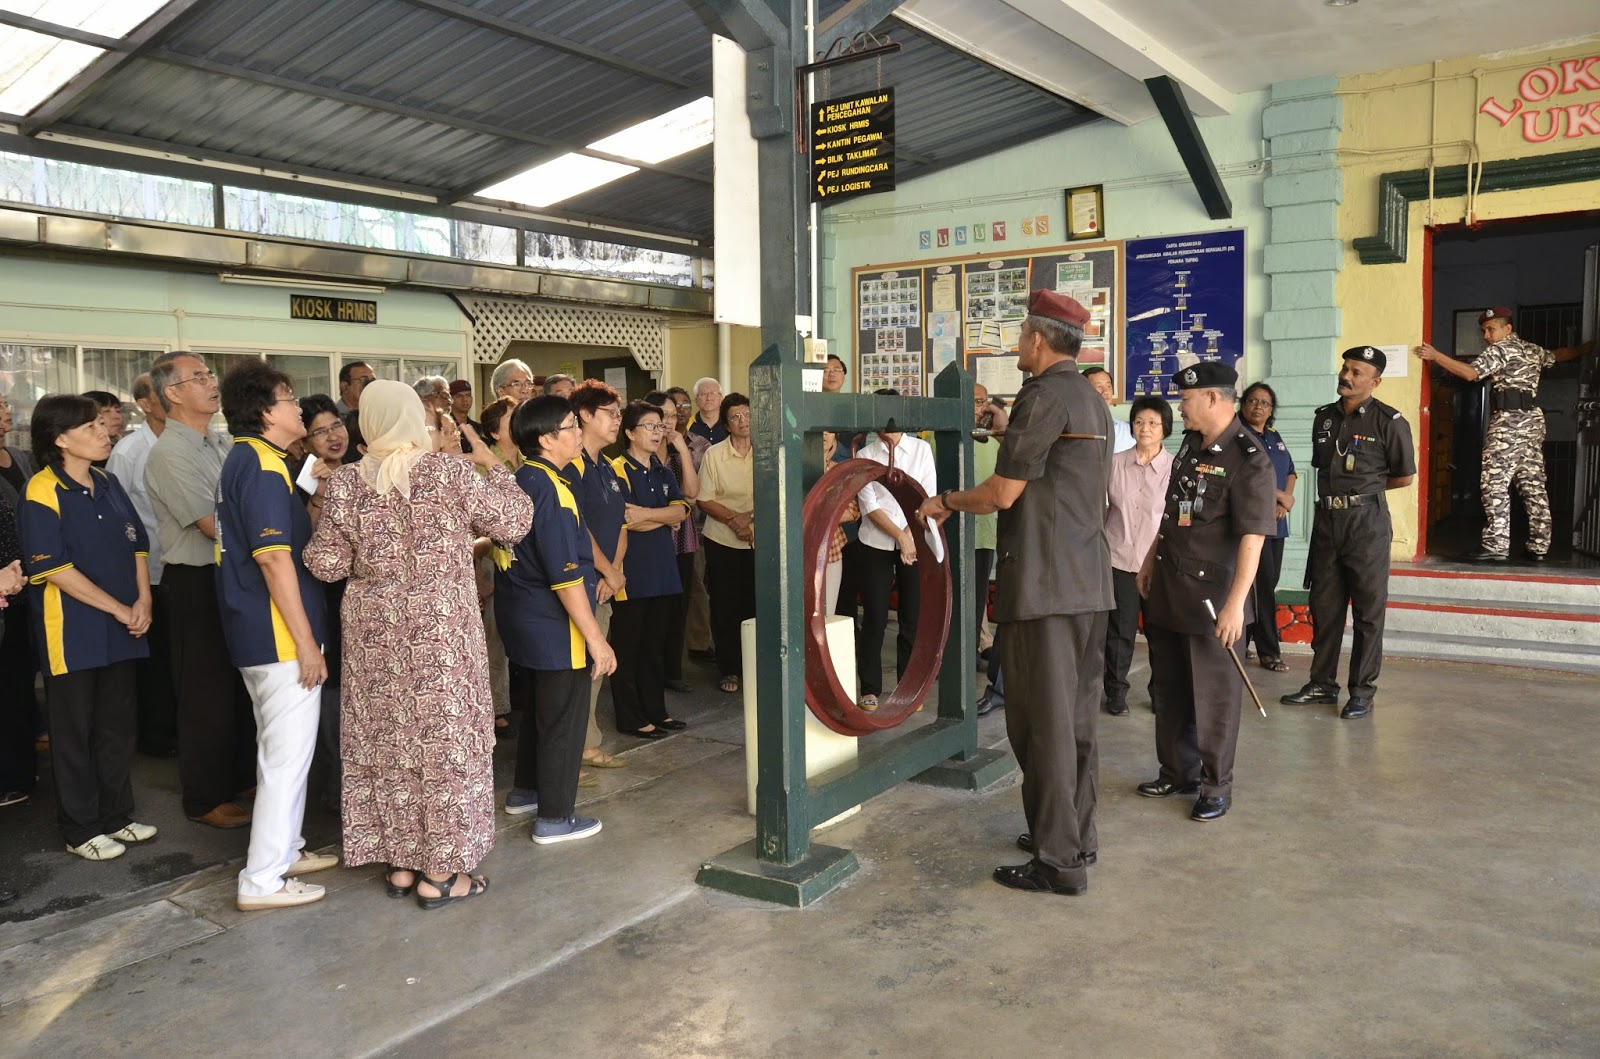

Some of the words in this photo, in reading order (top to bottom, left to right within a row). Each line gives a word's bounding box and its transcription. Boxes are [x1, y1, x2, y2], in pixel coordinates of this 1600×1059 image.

[827, 105, 839, 114] PEJ
[840, 101, 854, 112] UNIT
[855, 94, 888, 106] KAWALAN
[827, 106, 871, 121] PENCEGAHAN
[827, 123, 847, 134] KIOSK
[849, 119, 870, 130] HRMIS
[827, 138, 851, 149] KANTIN
[853, 132, 883, 144] PEGAWAI
[827, 154, 843, 164] BILIK
[846, 148, 878, 160] TAKLIMAT
[827, 170, 839, 178] PEJ
[842, 163, 888, 176] RUNDINGCARA
[827, 185, 839, 194] PEJ
[841, 181, 871, 191] LOGISTIK
[292, 298, 333, 319] KIOSK
[337, 301, 376, 321] HRMIS
